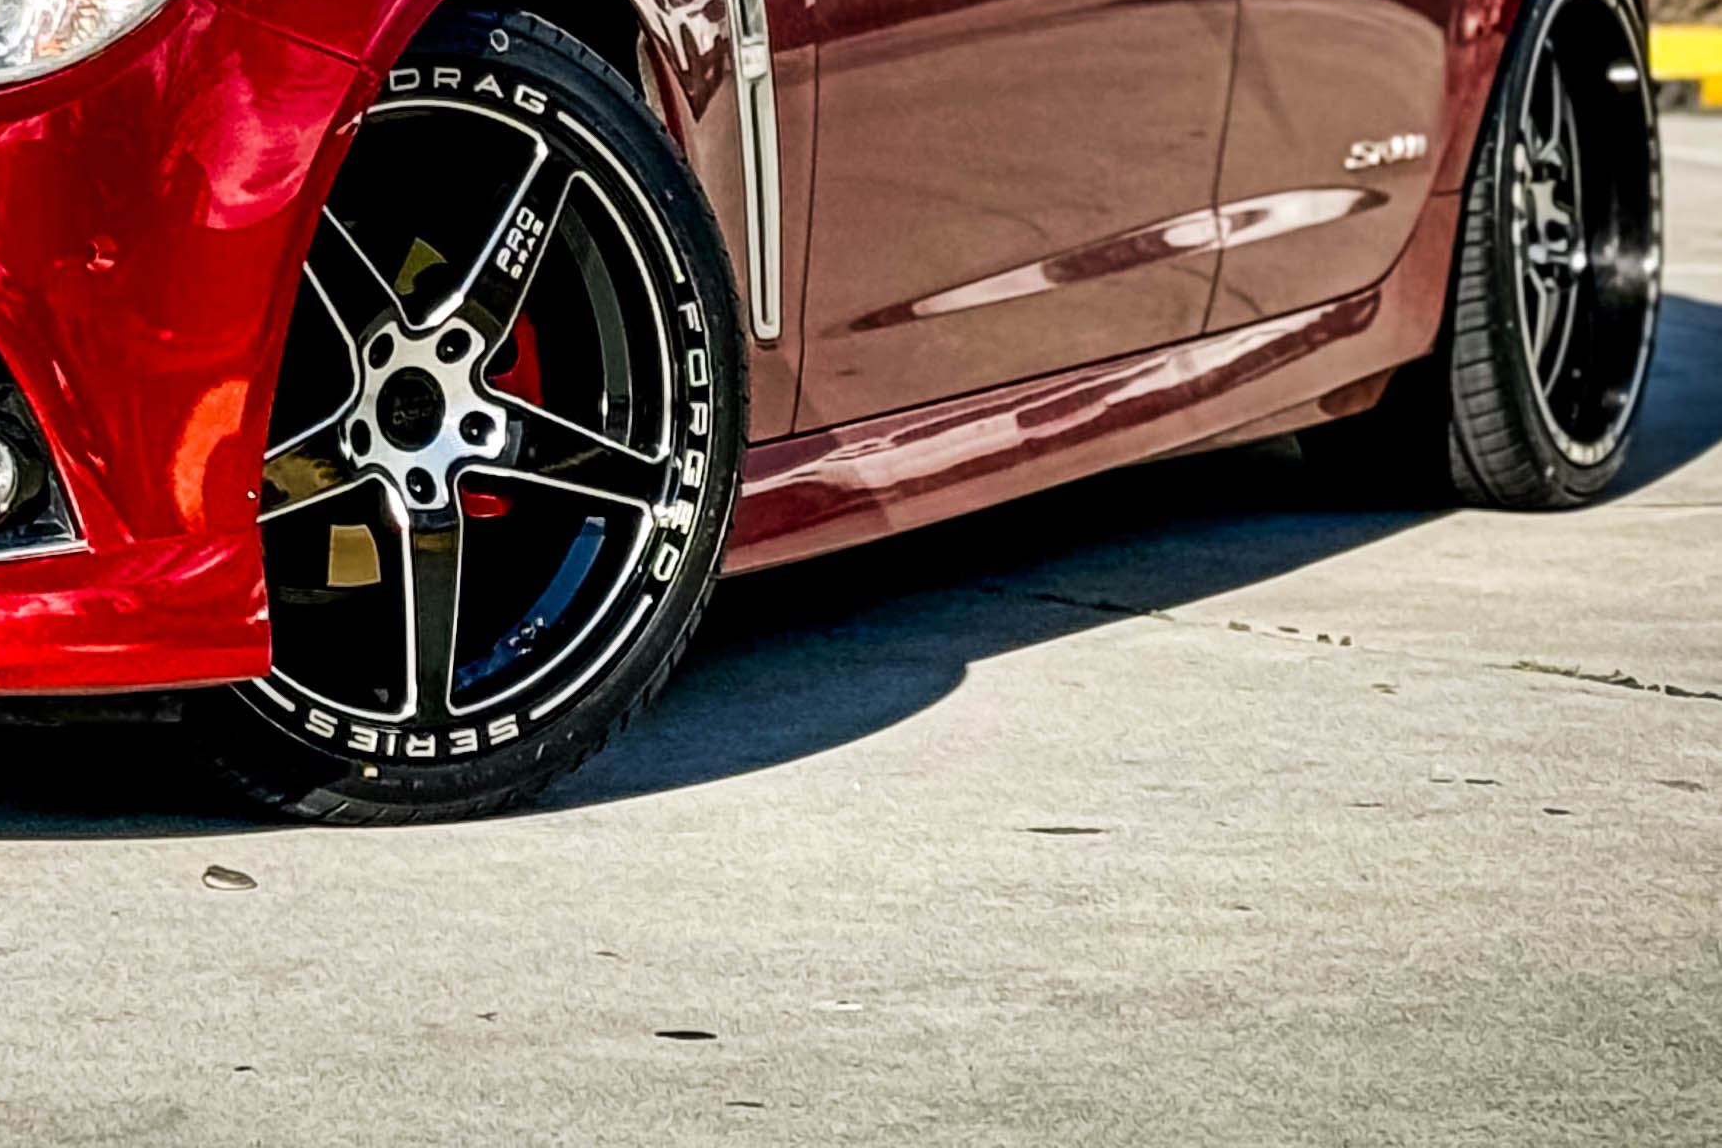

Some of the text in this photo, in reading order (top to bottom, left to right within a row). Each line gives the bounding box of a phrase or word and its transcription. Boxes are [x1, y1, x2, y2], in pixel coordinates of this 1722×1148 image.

[389, 66, 548, 115] DRAG
[496, 206, 535, 272] PRO
[653, 302, 709, 582] FORGED
[304, 708, 520, 757] SERIES
